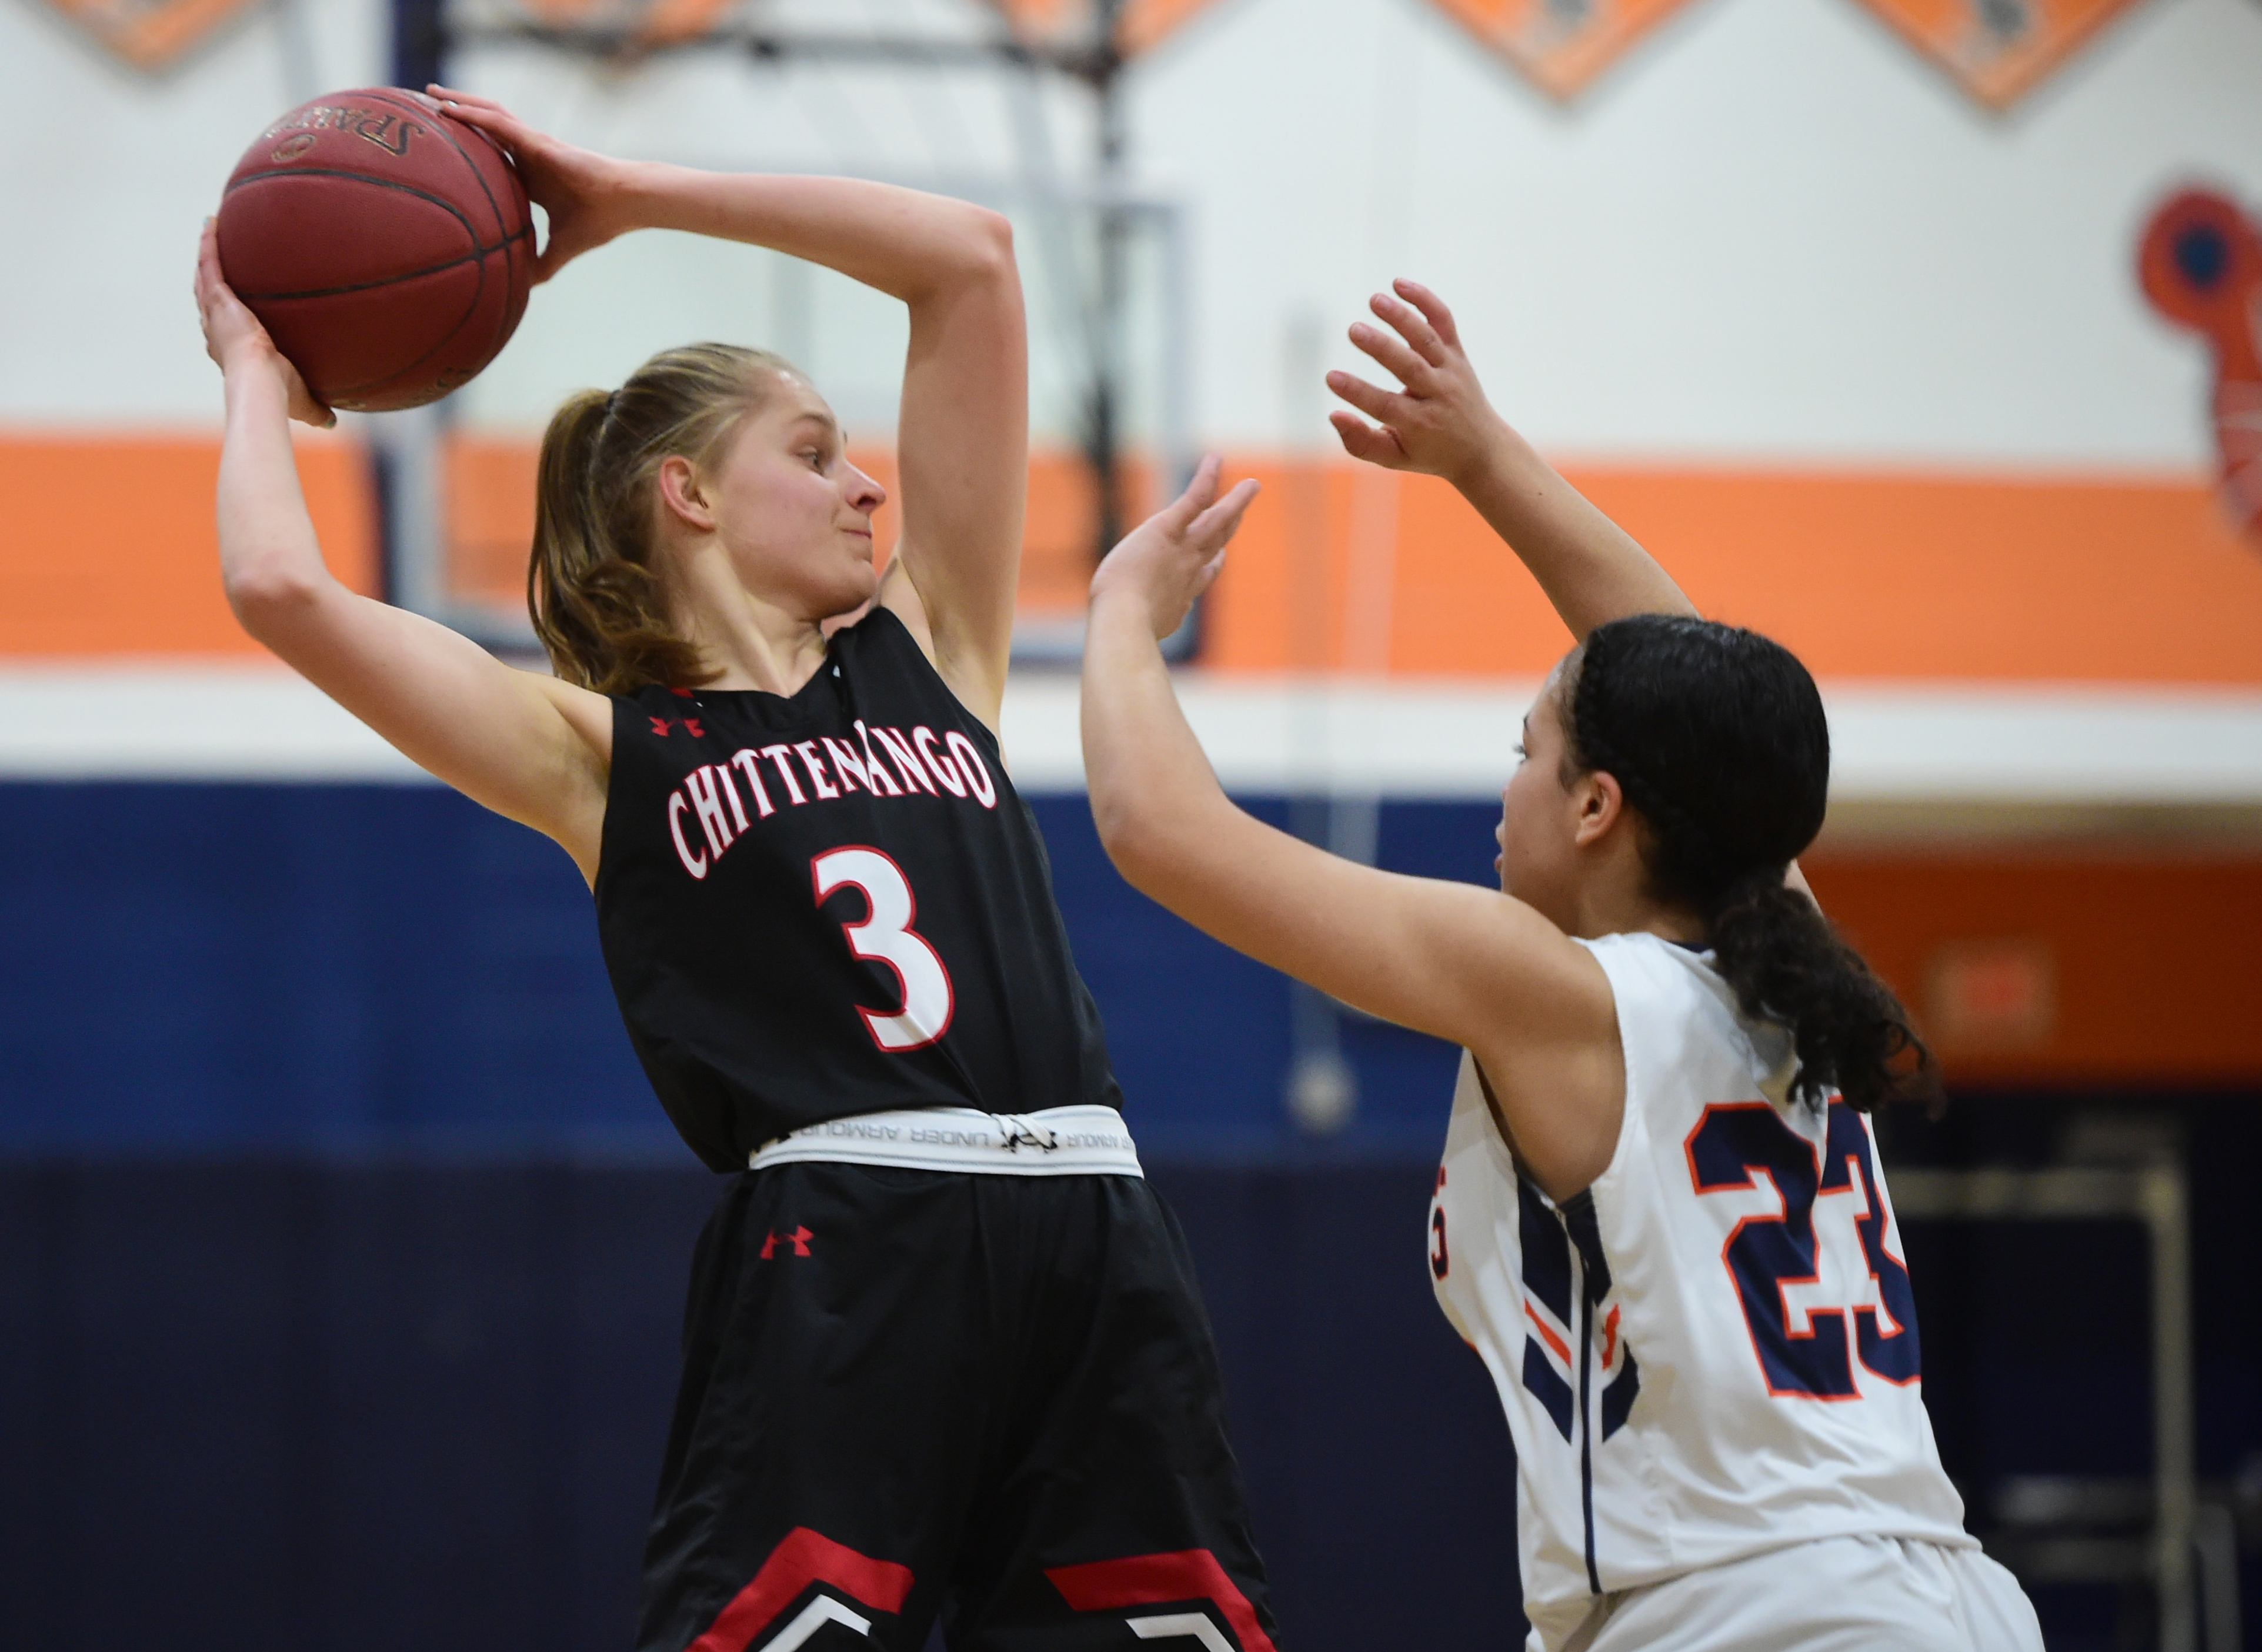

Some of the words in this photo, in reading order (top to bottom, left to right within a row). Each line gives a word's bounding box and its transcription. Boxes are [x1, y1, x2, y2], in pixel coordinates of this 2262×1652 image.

[669, 719, 997, 880] CHITTENANGO
[810, 844, 955, 1053] 3
[910, 1127, 989, 1146] UNDER
[1684, 1095, 1921, 1401] 23
